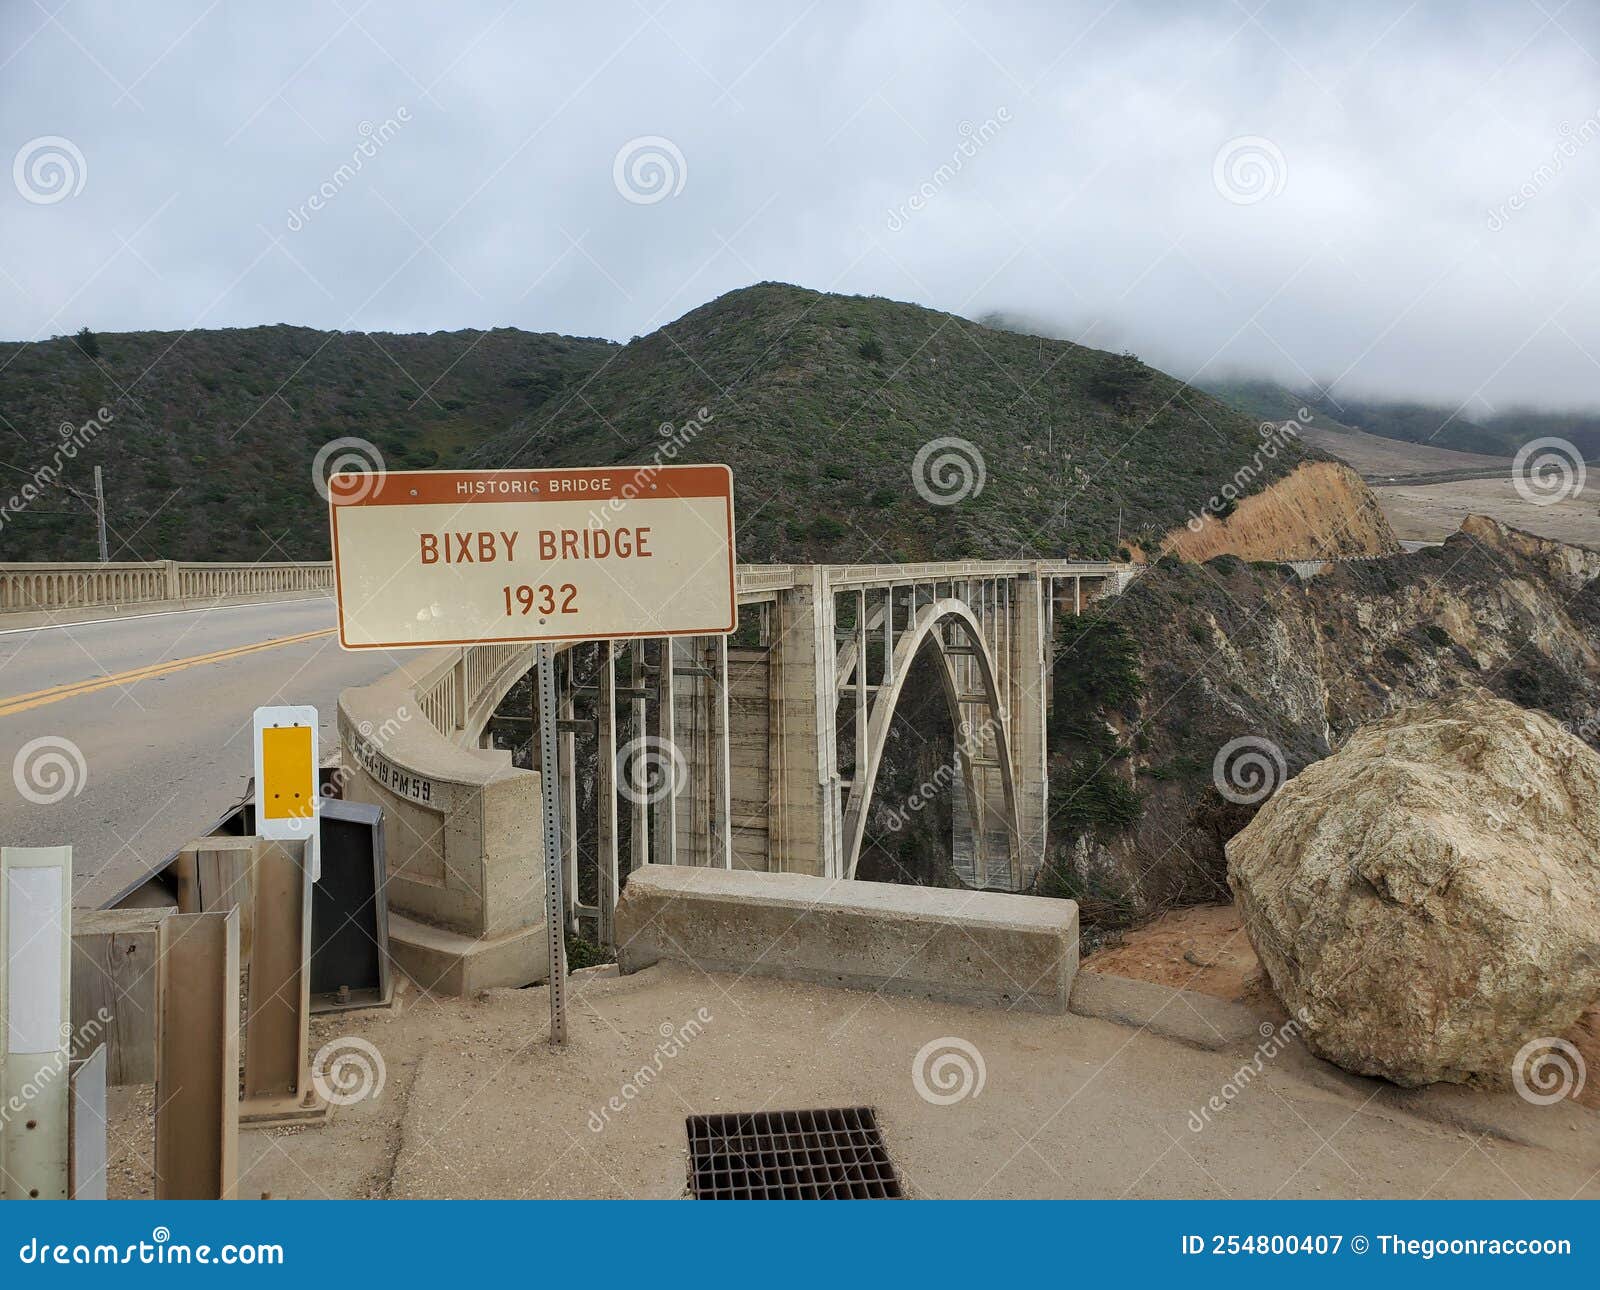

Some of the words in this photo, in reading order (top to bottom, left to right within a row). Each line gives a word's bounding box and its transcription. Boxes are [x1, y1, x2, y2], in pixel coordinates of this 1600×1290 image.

[456, 480, 539, 494] HISTORIC
[549, 478, 612, 492] BRIDGE
[420, 530, 519, 565] BIXBY
[538, 526, 653, 561] BRIDGE
[502, 583, 579, 616] 1932
[392, 770, 409, 796] PM
[412, 778, 431, 801] 59
